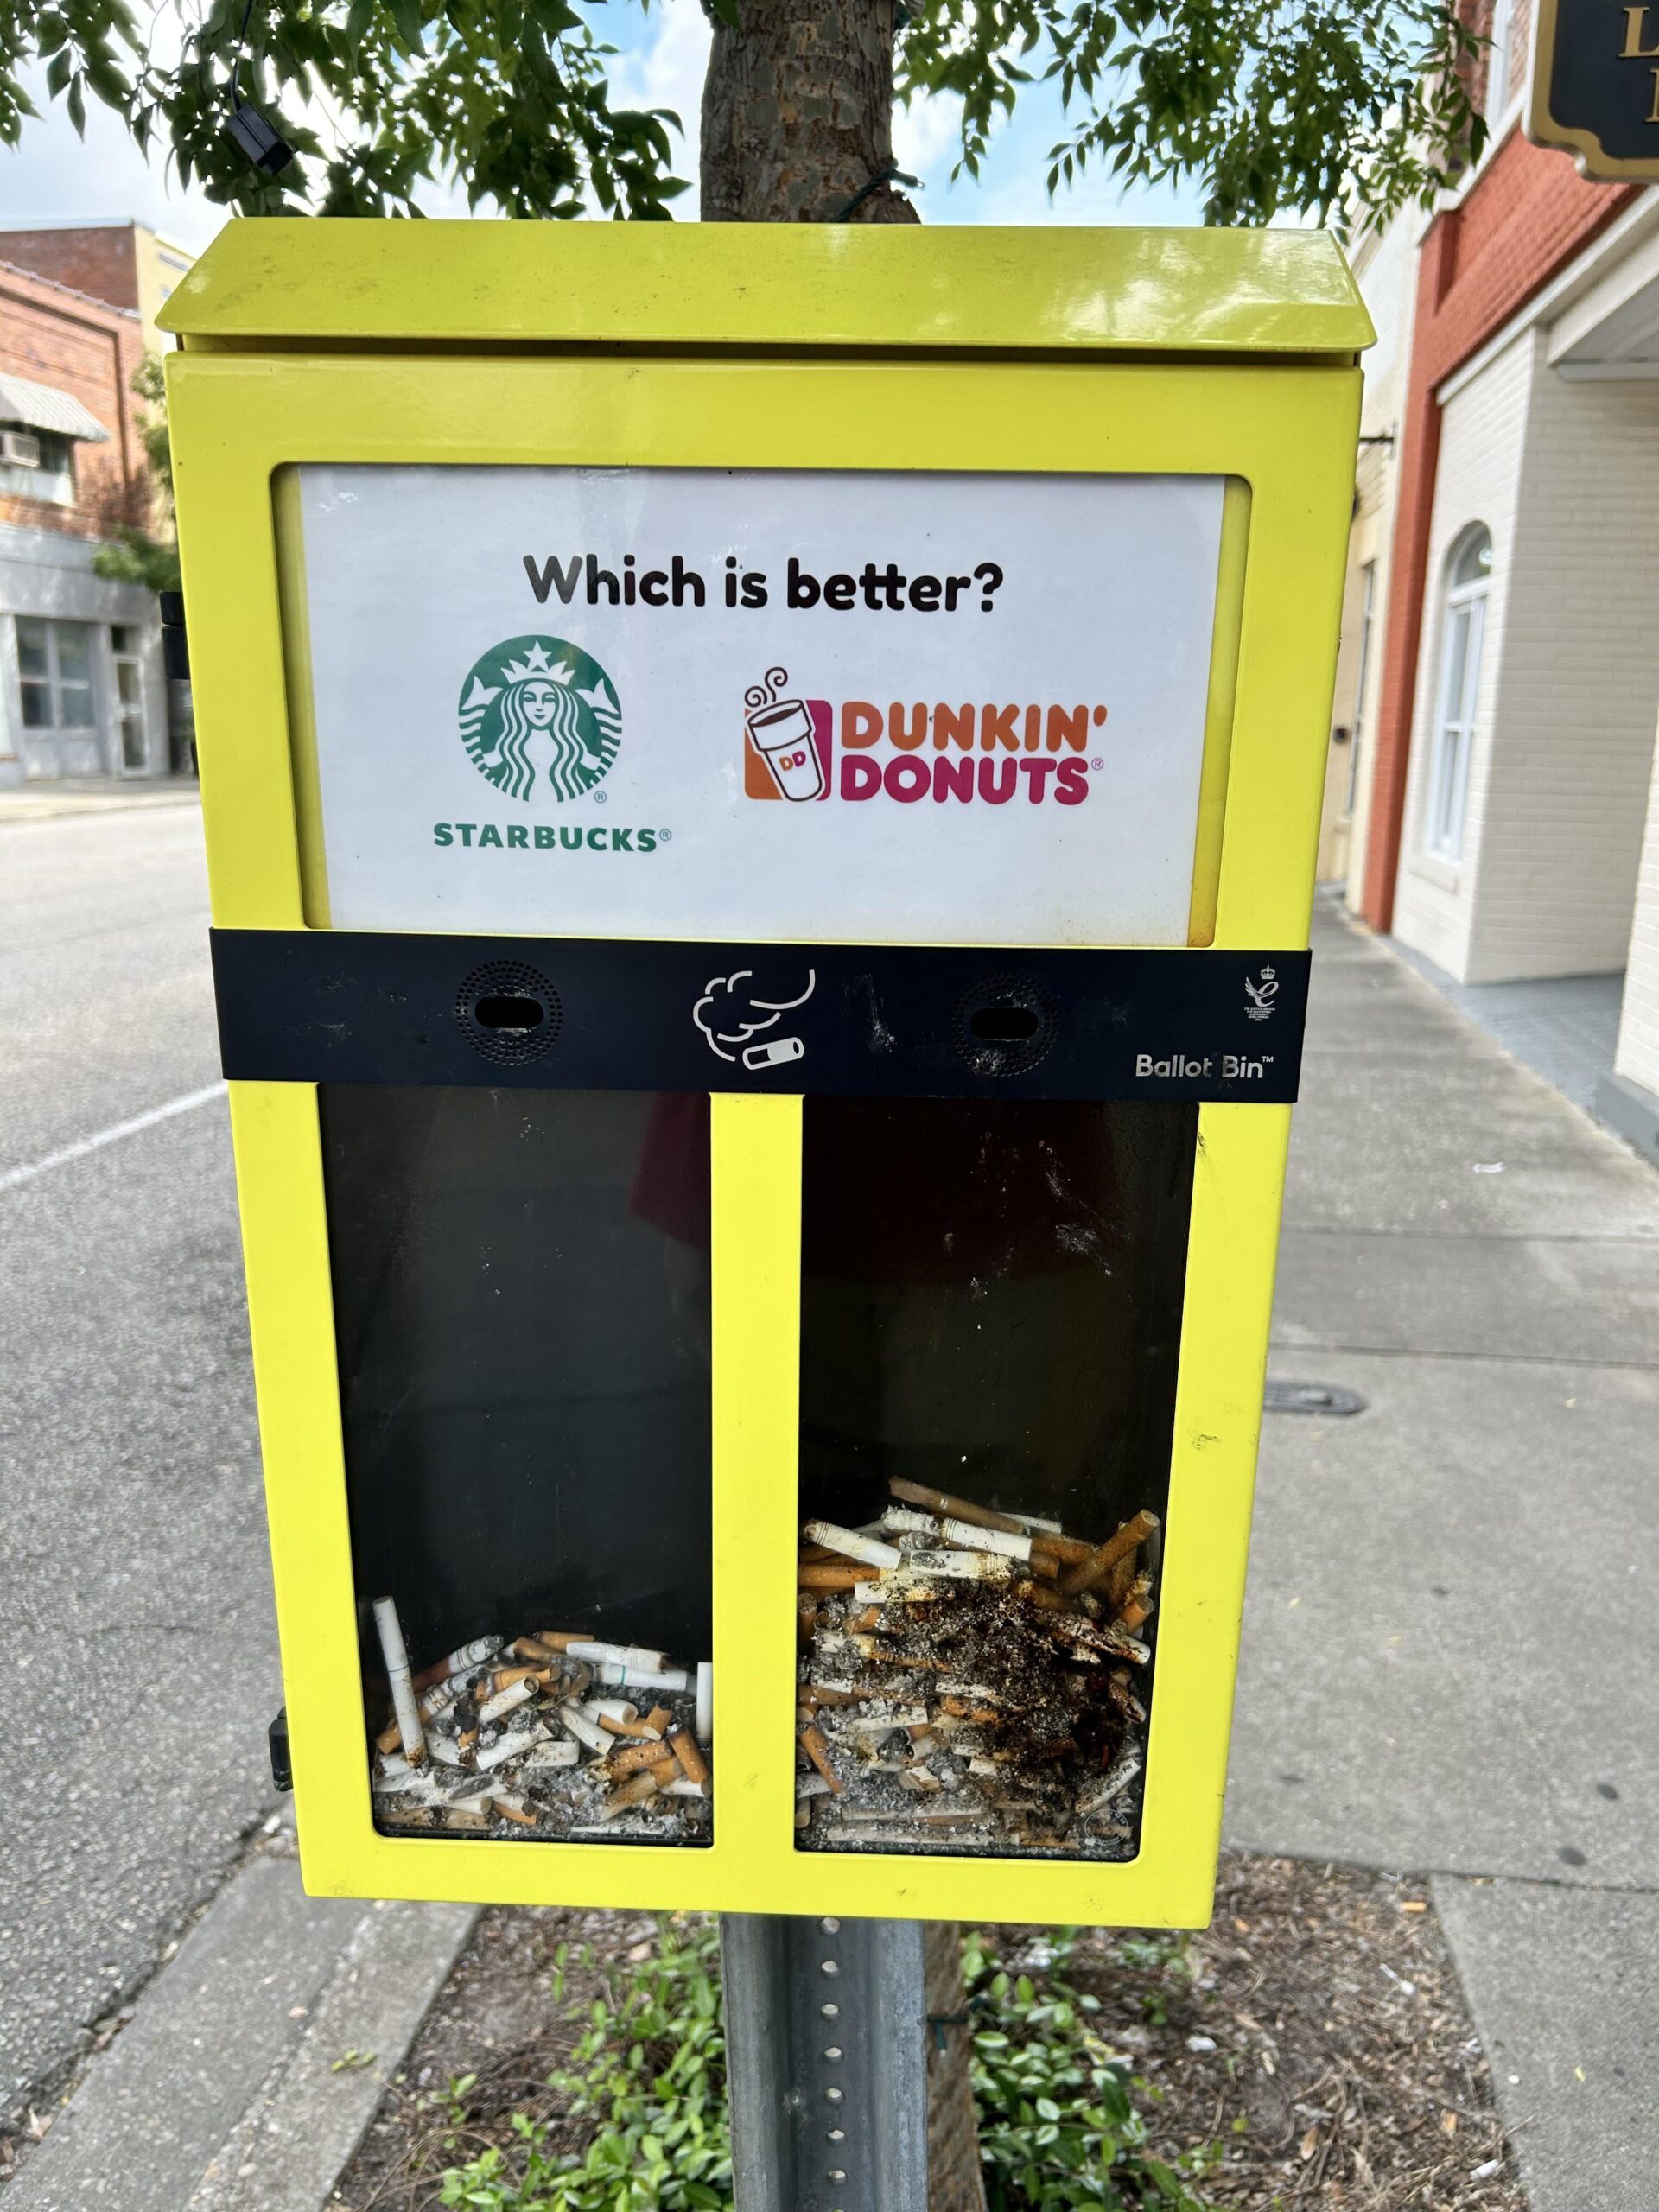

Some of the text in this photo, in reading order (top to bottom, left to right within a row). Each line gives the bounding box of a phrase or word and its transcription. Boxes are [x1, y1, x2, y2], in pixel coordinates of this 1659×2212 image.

[524, 554, 1003, 612] Which is better?
[842, 702, 1107, 752] DUNKIN'
[779, 751, 805, 770] DD
[1136, 1054, 1212, 1077] Ballot
